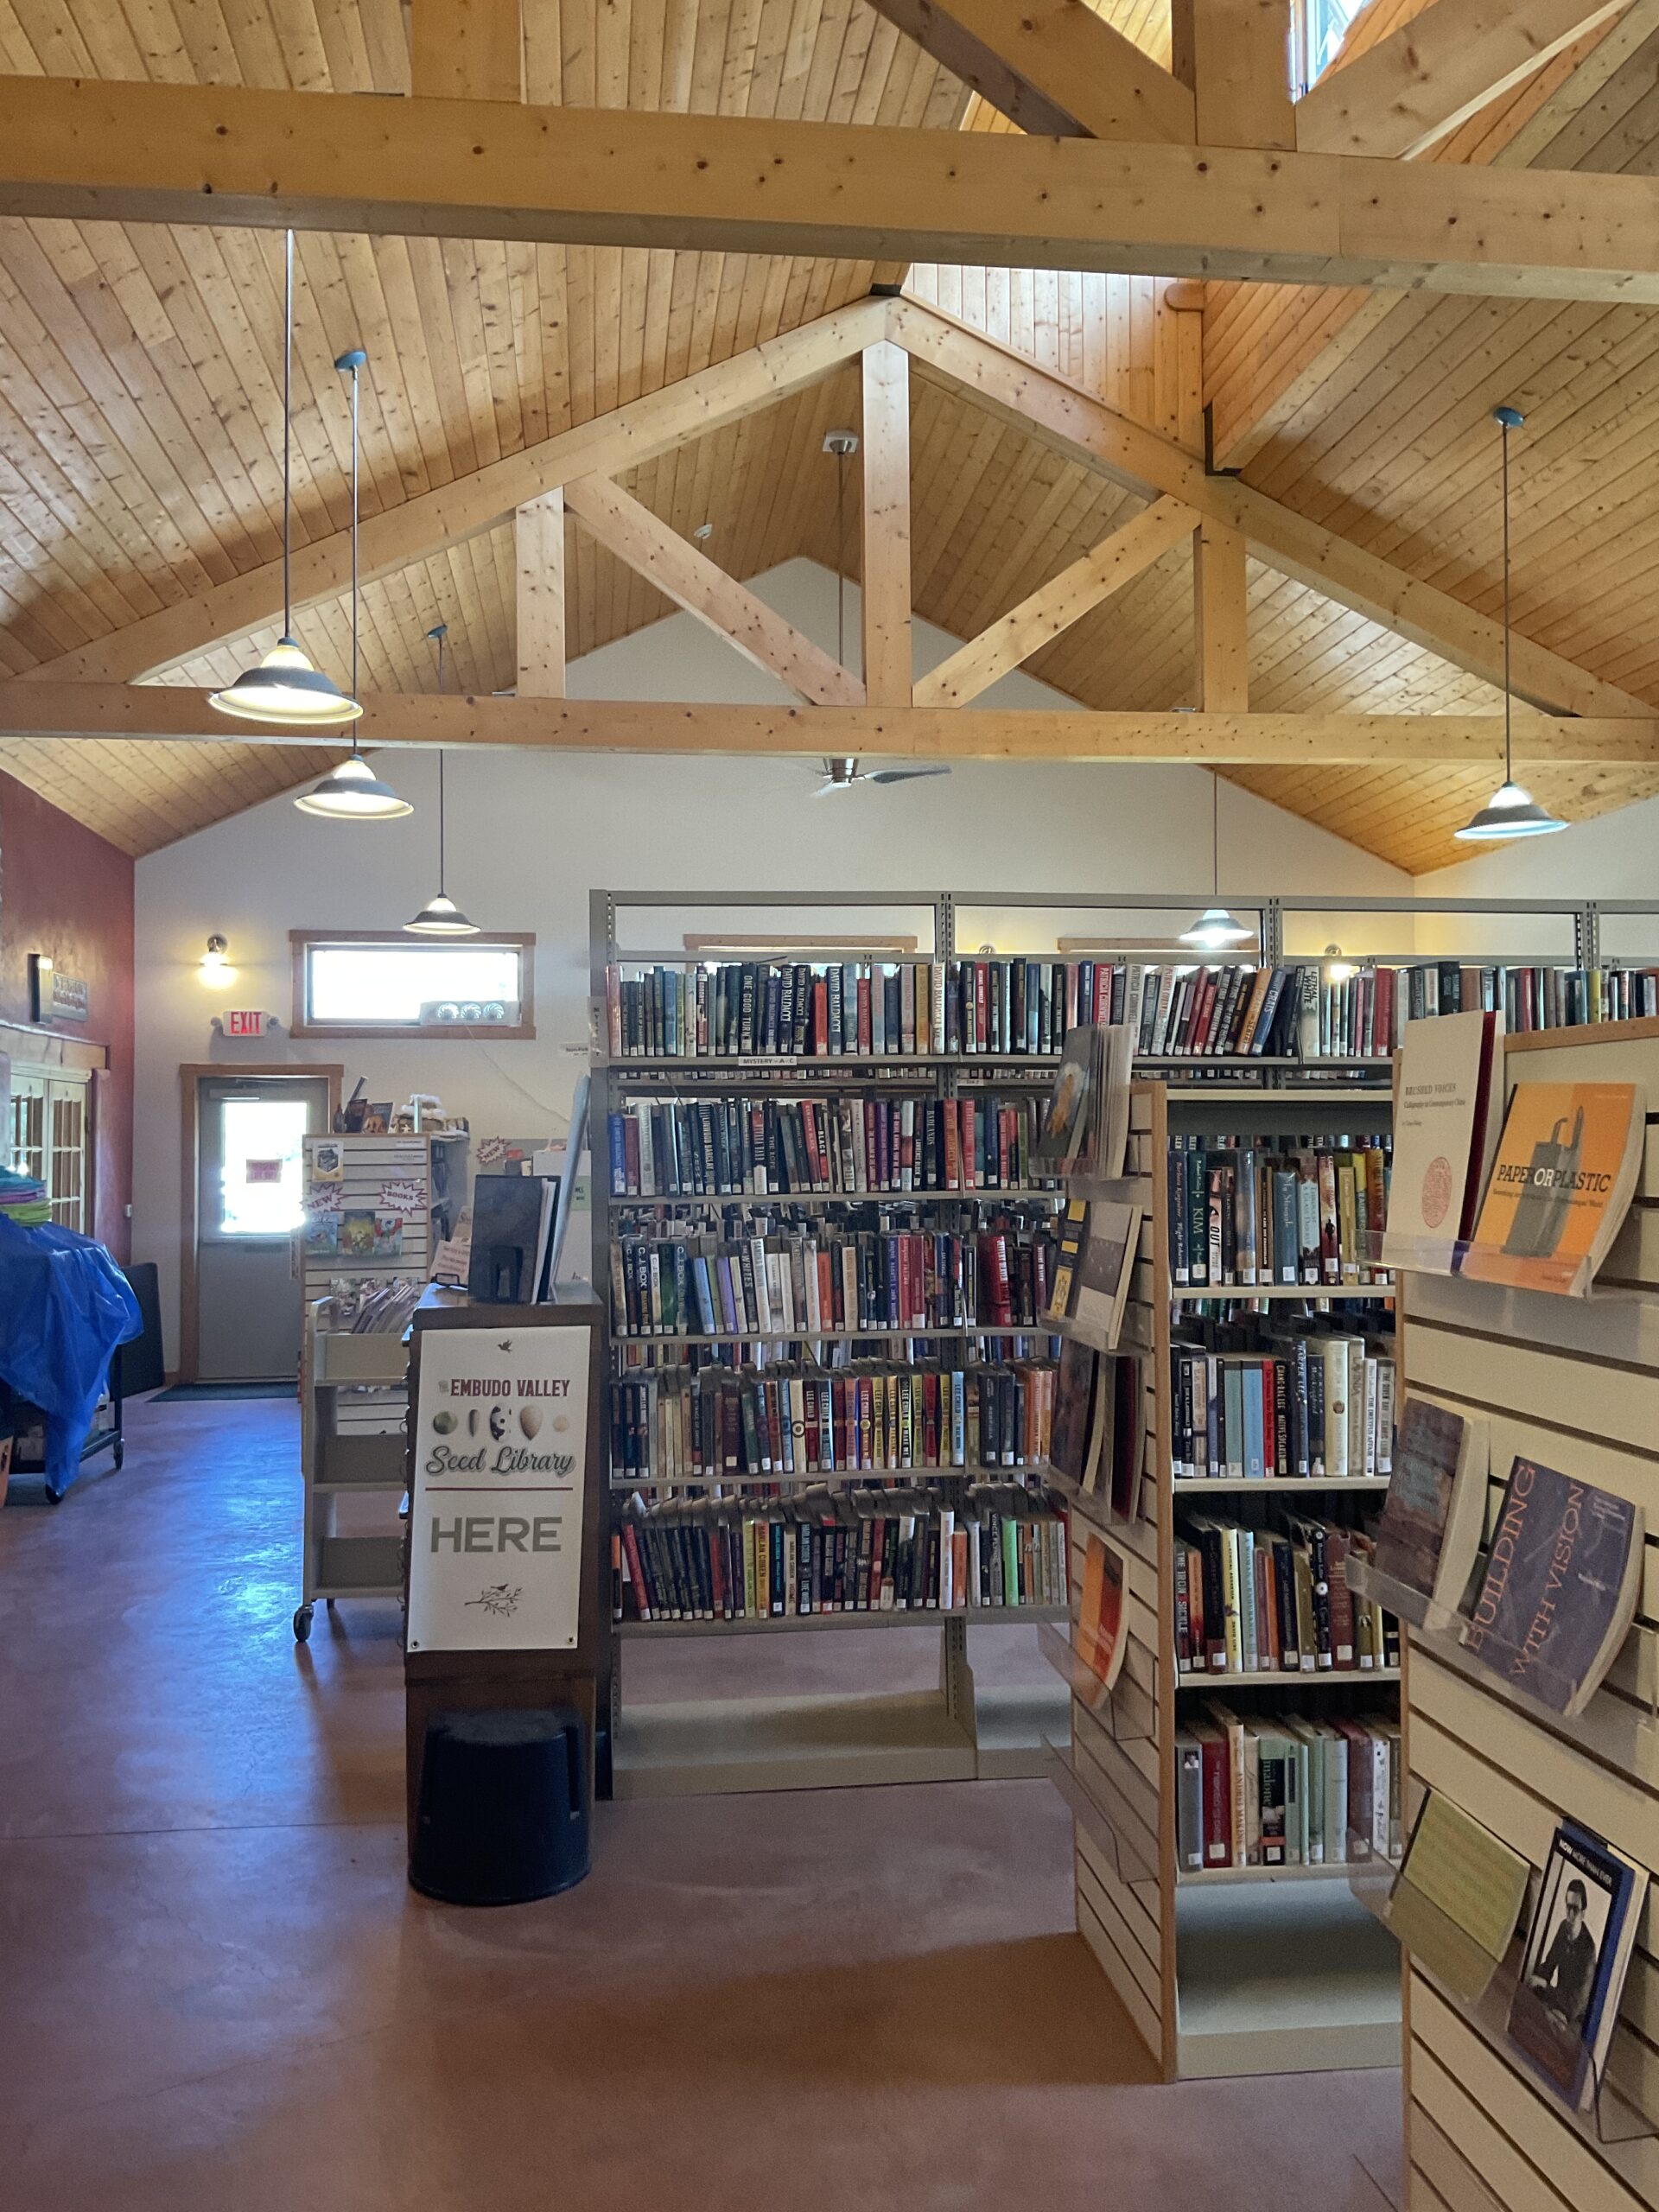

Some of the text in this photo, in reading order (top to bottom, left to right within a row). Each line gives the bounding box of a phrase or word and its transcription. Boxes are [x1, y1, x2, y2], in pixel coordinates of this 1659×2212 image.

[742, 976, 753, 1037] ONE GOOD TURN
[781, 968, 792, 1021] DAVID BALDACCI
[1098, 968, 1109, 1025] PATRICIA CORNWELL
[1129, 966, 1141, 1023] PATRICIA CORNWELL
[1160, 968, 1173, 1018] PATRICIA CORNWELL
[1264, 990, 1280, 1013] CRAIS
[231, 1012, 261, 1033] EXIT
[831, 995, 840, 1032] BALDACCI
[1144, 1000, 1154, 1025] CORNWELL
[1435, 1083, 1456, 1093] VOICES
[702, 1117, 714, 1169] LINWOOD BARCLAY
[755, 1124, 764, 1145] NEVADA
[926, 1110, 935, 1145] BADLANDS
[483, 1146, 501, 1161] NEW
[387, 1191, 414, 1201] BOOKS
[1192, 1208, 1203, 1234] KIM
[1210, 1226, 1220, 1248] OUT
[639, 1247, 645, 1256] C.
[677, 1246, 684, 1255] C.
[997, 1240, 1007, 1281] JEFFERY DEAVER
[743, 1255, 752, 1287] WHITES
[450, 1379, 512, 1397] EMBUDO
[518, 1379, 570, 1397] VALLEY
[1351, 1357, 1362, 1396] LAVINIA
[861, 1390, 869, 1401] LEE
[1277, 1399, 1286, 1408] LEE
[425, 1446, 576, 1478] Seed Library
[903, 1446, 909, 1455] ME
[1278, 1434, 1287, 1459] SPEAKER
[430, 1516, 563, 1553] HERE
[1465, 1464, 1536, 1651] BUILDING
[1177, 1552, 1188, 1633] THE IRON SICKLE
[1510, 1484, 1586, 1675] WITH VISION
[1262, 1760, 1274, 1806] malone
[1559, 1839, 1573, 1854] NOW
[1599, 1871, 1612, 1887] EVER
